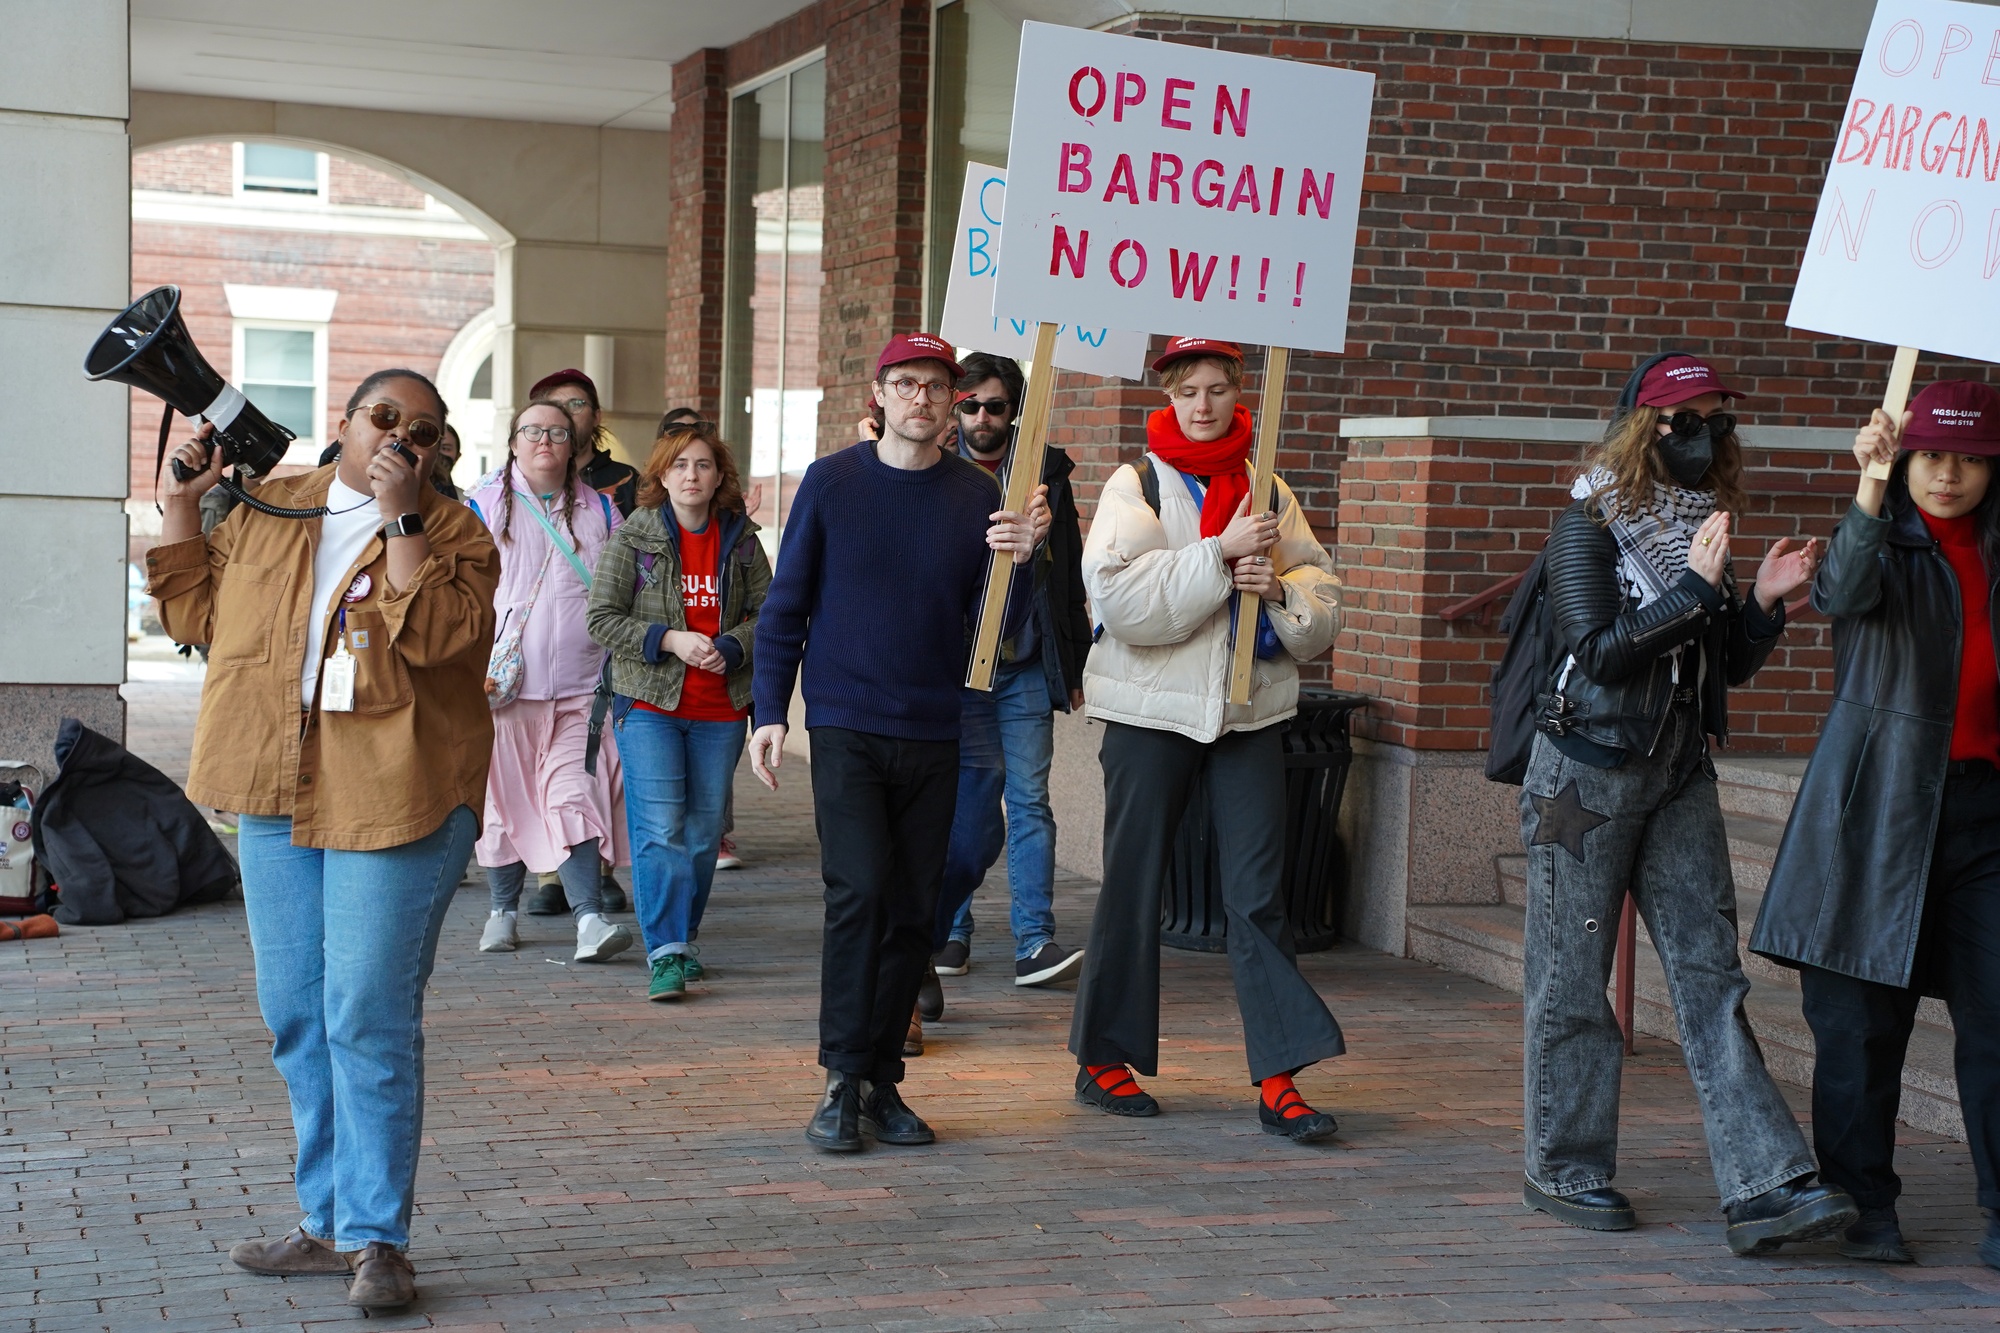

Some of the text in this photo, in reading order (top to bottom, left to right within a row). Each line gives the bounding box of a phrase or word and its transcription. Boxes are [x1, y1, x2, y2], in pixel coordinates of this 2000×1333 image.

[1068, 66, 1251, 137] OPEN
[1057, 142, 1335, 220] BARGAIN
[1050, 224, 1307, 307] NOW!!!
[1932, 408, 1982, 418] HGSU-UAW
[1938, 418, 1957, 426] Local
